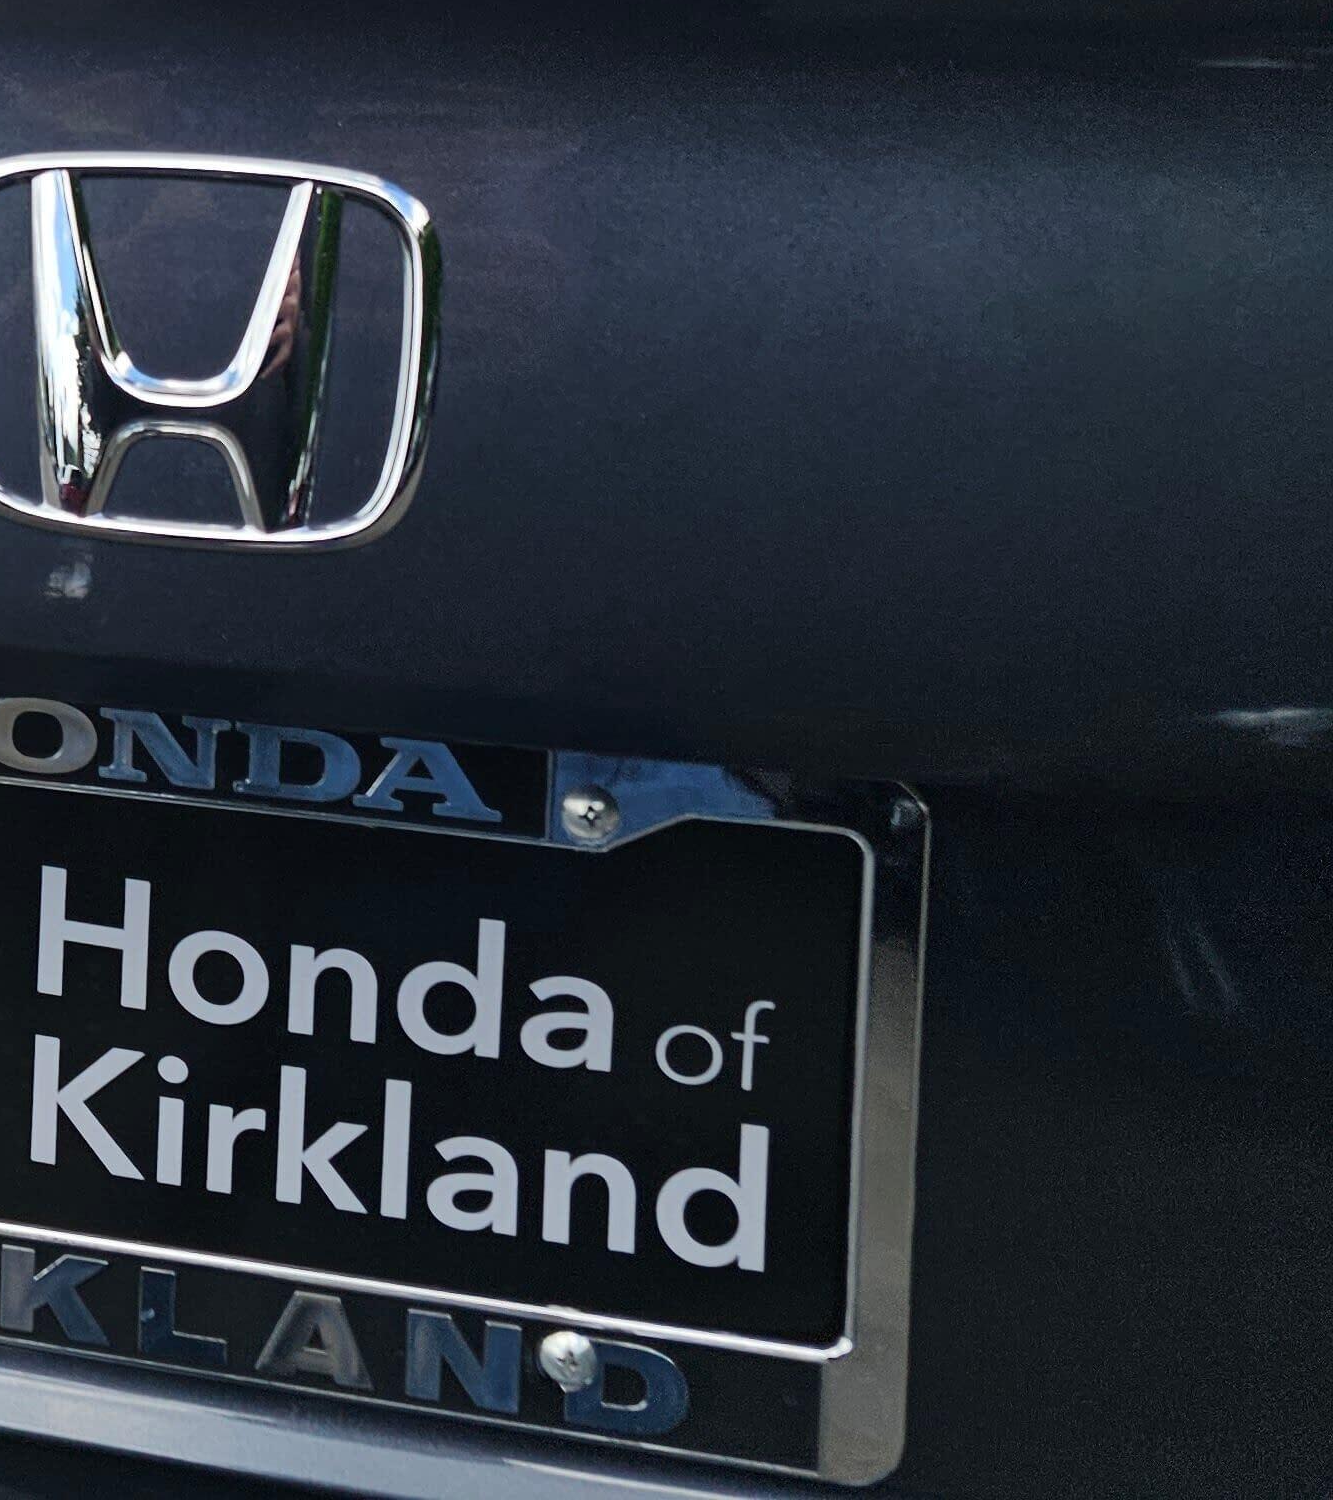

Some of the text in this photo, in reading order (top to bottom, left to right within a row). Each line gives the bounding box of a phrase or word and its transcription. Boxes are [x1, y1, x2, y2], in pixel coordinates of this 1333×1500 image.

[36, 864, 776, 1091] Honda of
[29, 1034, 770, 1273] Kirkland
